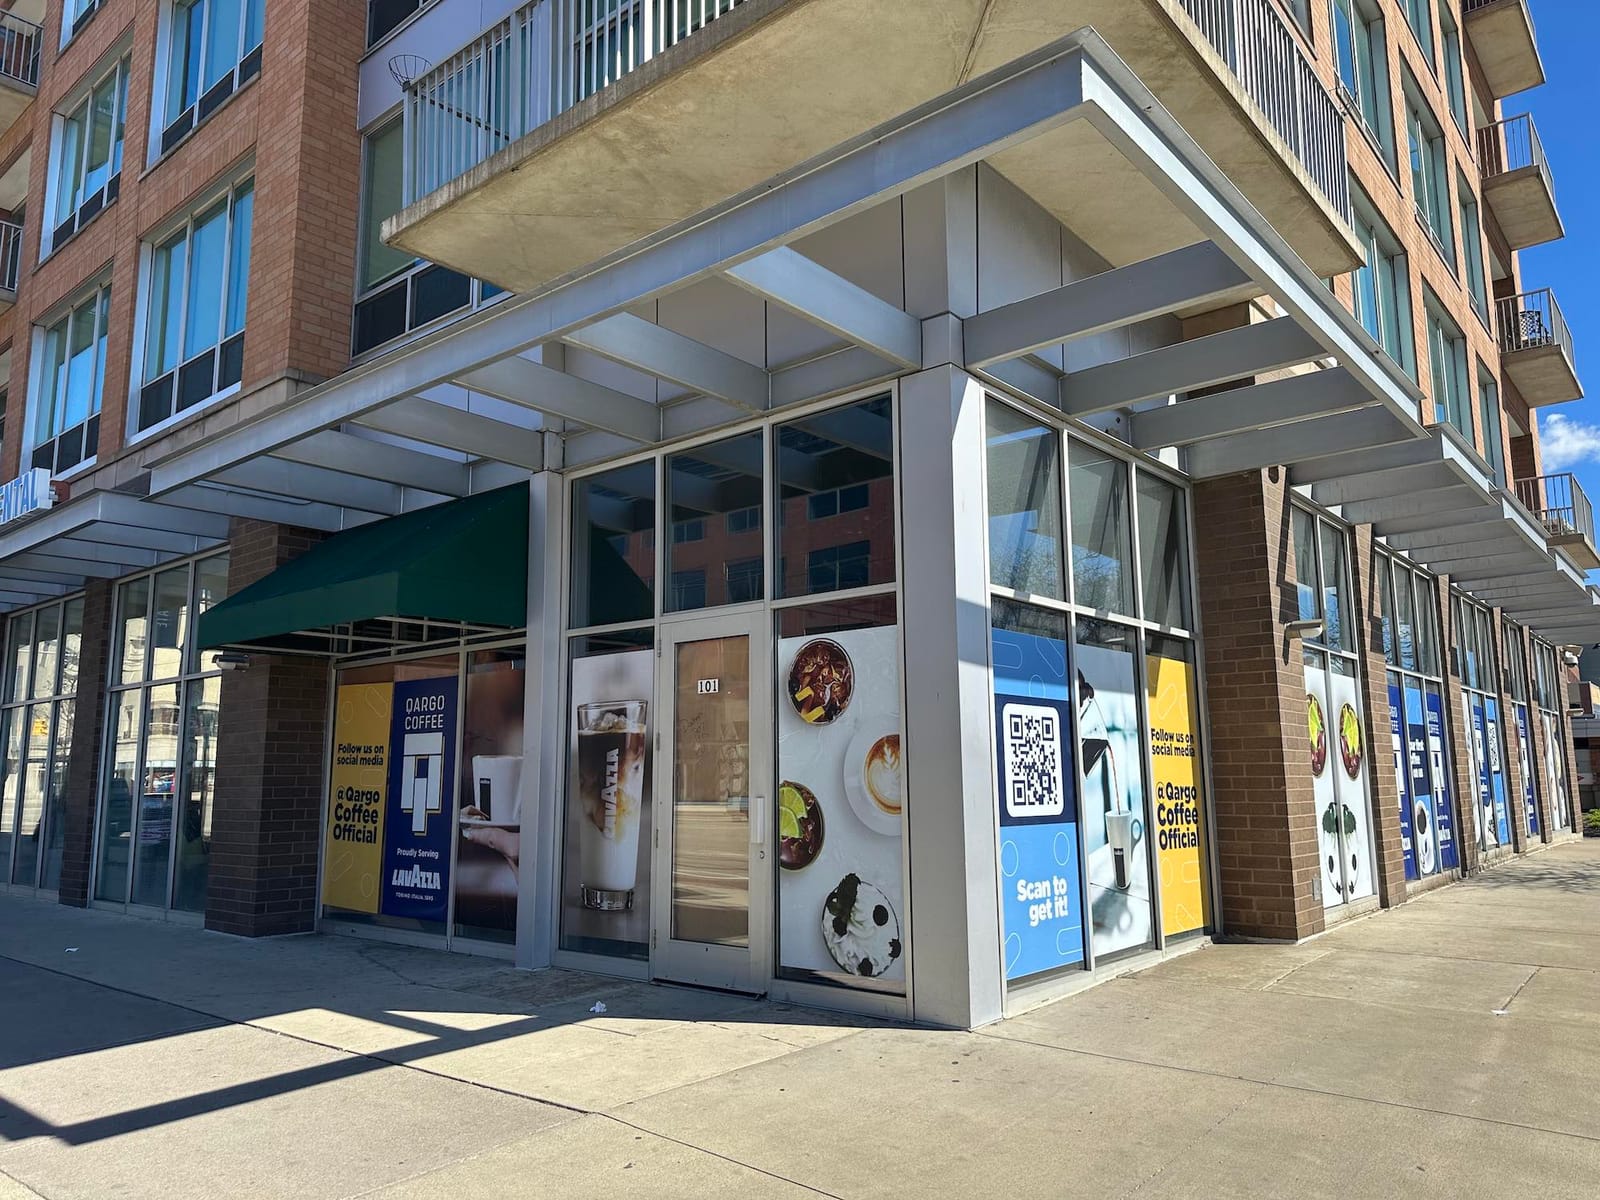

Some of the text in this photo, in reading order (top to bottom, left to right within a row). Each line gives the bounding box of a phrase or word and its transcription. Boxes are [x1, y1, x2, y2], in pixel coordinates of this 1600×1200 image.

[699, 680, 718, 692] 101
[406, 695, 445, 715] QARGO
[404, 714, 444, 730] COFFEE
[1151, 728, 1194, 744] Follow us on
[338, 744, 384, 754] Follow us on
[1152, 743, 1195, 757] social media
[337, 755, 384, 766] social media
[336, 785, 380, 806] @Qargo
[1156, 781, 1197, 804] @Qargo
[335, 803, 379, 824] Coffee
[1157, 802, 1199, 827] Coffee
[333, 823, 377, 844] Official
[1159, 826, 1200, 850] Official
[397, 848, 439, 860] Proudly Serving
[392, 864, 441, 890] LAVAZZA
[1017, 875, 1067, 901] Scan to
[1029, 895, 1068, 926] get it!
